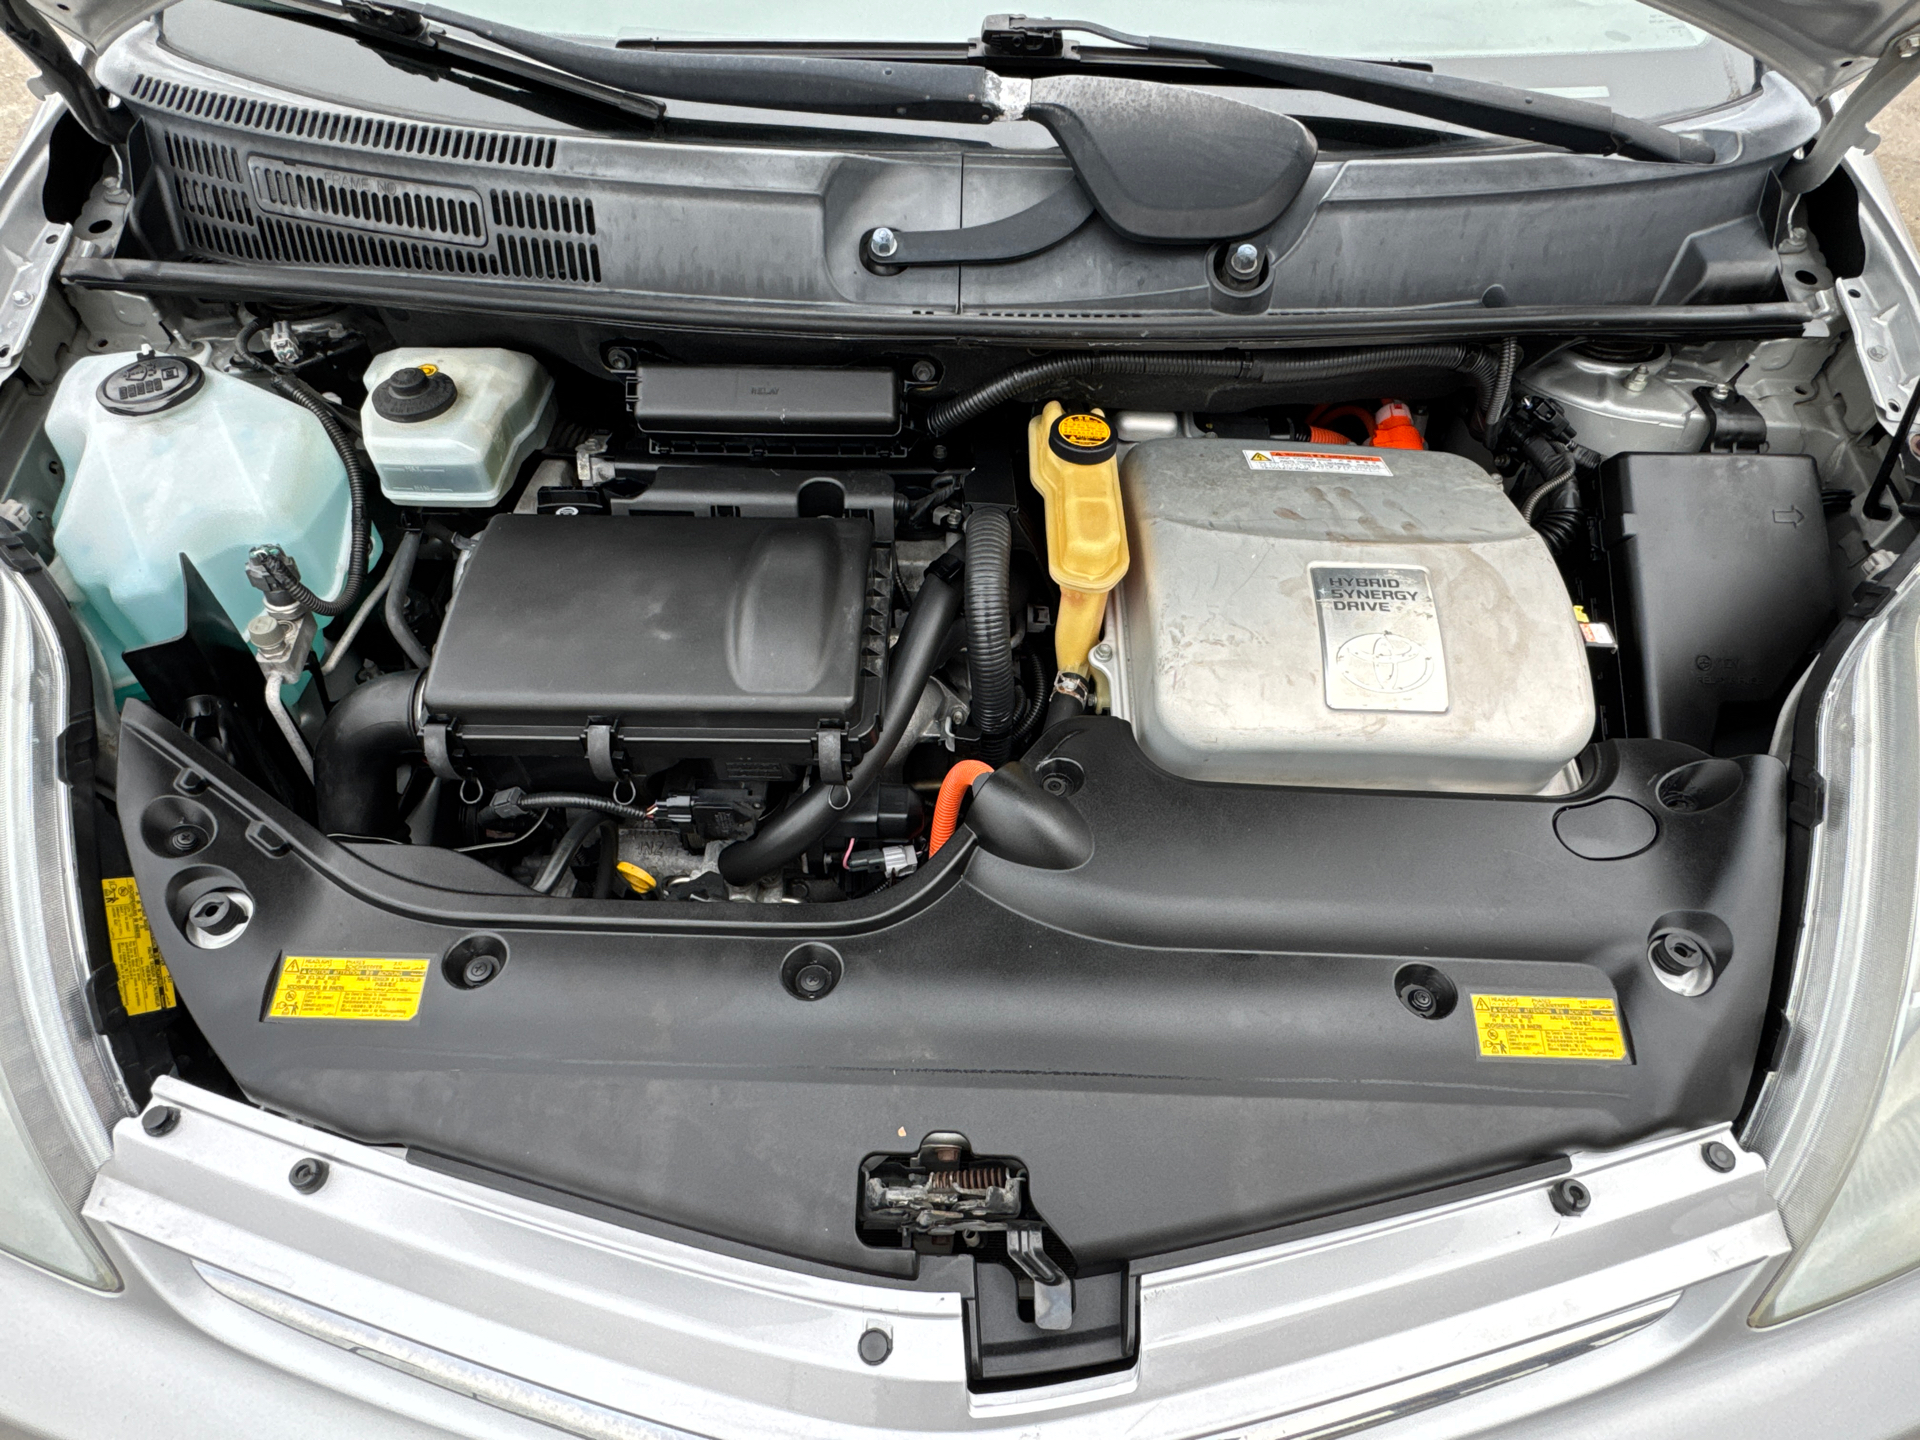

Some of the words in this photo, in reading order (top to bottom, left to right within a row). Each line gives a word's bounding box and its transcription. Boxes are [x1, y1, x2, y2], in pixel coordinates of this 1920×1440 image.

[324, 171, 370, 191] FRAME
[1329, 577, 1400, 588] HYBRID
[1331, 588, 1418, 602] SYNERGY
[1333, 600, 1391, 612] DRIVE
